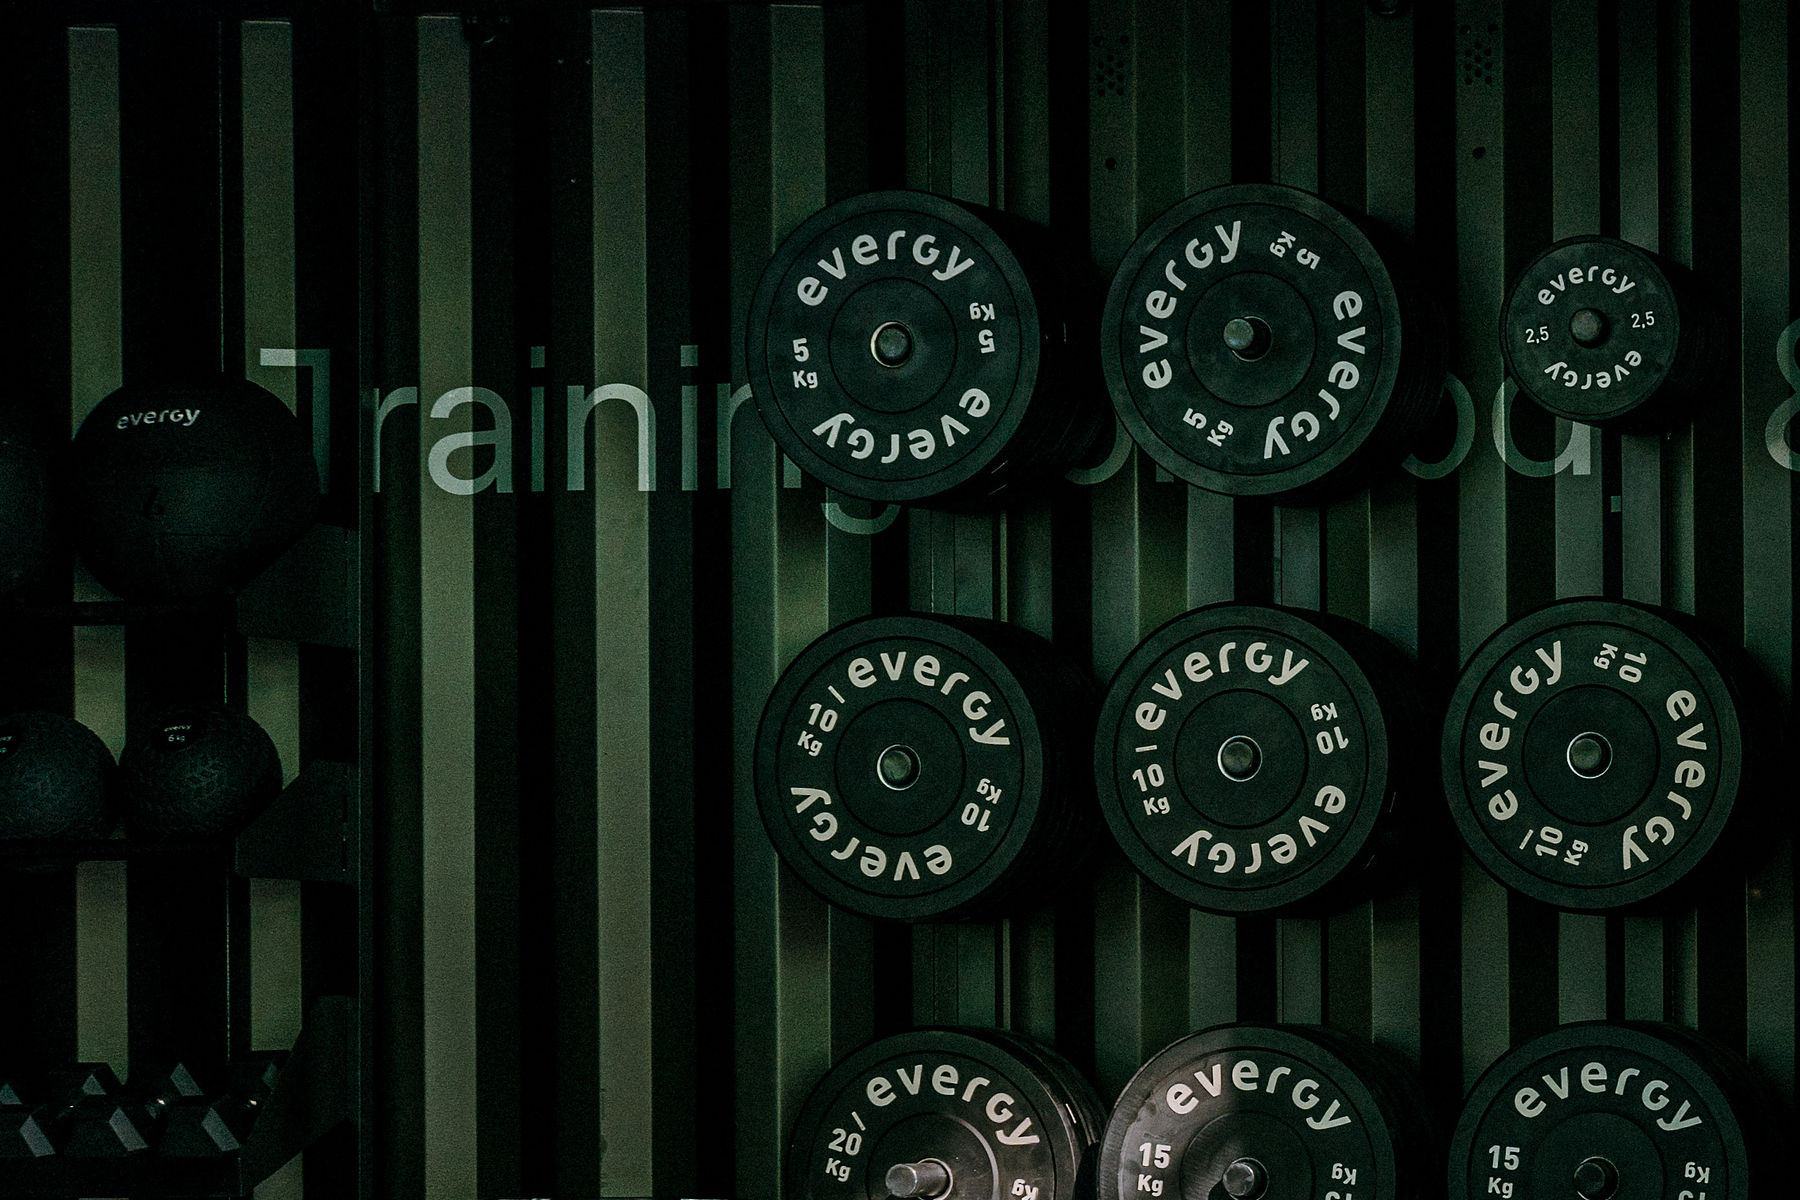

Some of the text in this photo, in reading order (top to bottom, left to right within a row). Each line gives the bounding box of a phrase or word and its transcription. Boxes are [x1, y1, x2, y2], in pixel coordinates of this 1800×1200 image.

[1269, 230, 1297, 258] Kg
[1296, 248, 1321, 270] 5
[969, 301, 996, 322] Kg
[1630, 310, 1655, 329] 2,5
[978, 329, 996, 354] 5
[1525, 325, 1550, 344] 2,5
[792, 337, 810, 363] 5
[792, 369, 819, 389] Kg
[1182, 407, 1207, 430] 5
[260, 344, 900, 535] Trainin
[1206, 419, 1234, 447] Kg
[1593, 642, 1619, 670] Kg
[1618, 652, 1648, 684] 10
[808, 702, 839, 733] 10
[1310, 702, 1339, 722] Kg
[797, 730, 823, 757] Kg
[1315, 726, 1350, 755] 10
[976, 777, 1003, 805] Kg
[1132, 763, 1165, 792] 10
[960, 802, 991, 832] 10
[1142, 796, 1171, 816] Kg
[1534, 825, 1563, 857] 10
[1563, 839, 1589, 866] Kg
[827, 1127, 863, 1157] 20
[1138, 1142, 1172, 1169] 15
[824, 1157, 852, 1183] Kg
[1488, 1144, 1521, 1171] 15
[1137, 1173, 1164, 1197] Kg
[1331, 1162, 1358, 1186] Kg
[1684, 1161, 1710, 1184] Kg
[1487, 1176, 1514, 1199] Kg
